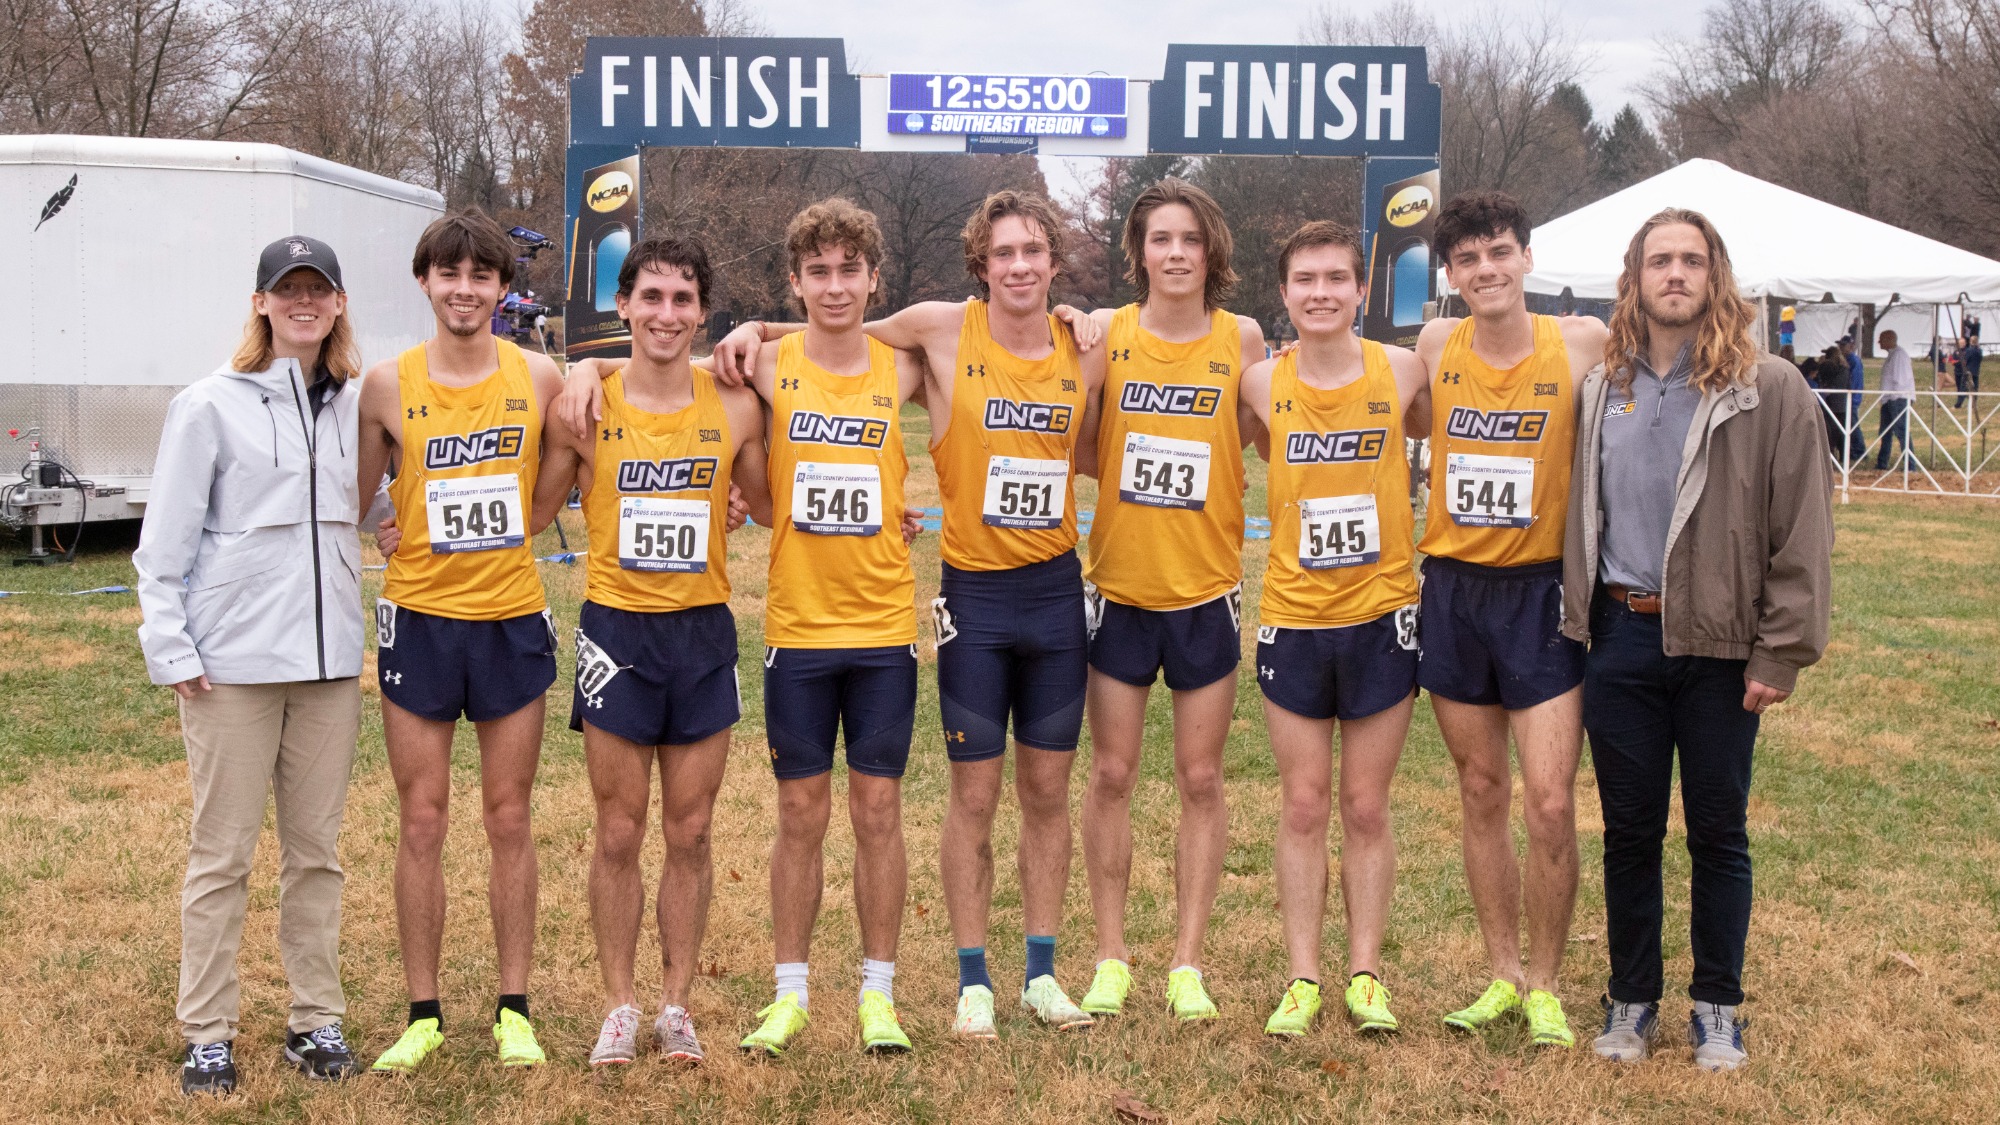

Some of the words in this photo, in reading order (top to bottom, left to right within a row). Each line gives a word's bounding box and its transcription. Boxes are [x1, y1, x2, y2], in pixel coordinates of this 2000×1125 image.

[601, 56, 829, 128] FINISH
[926, 75, 1091, 111] 12:55:00
[1184, 61, 1406, 140] FINISH
[931, 114, 1023, 133] SOUTHEAST
[1025, 117, 1085, 134] REGION
[979, 136, 1034, 144] CHAMPIONSHIPS
[590, 184, 630, 207] NCAA
[1389, 199, 1429, 221] NCAA
[1209, 361, 1231, 376] SOCON
[505, 398, 528, 412] SOCON
[872, 395, 893, 409] SOCON
[1120, 382, 1223, 417] UNCG
[1534, 383, 1558, 396] SOCON
[984, 398, 1073, 434] UNCG
[1368, 401, 1391, 415] SOCON
[1447, 408, 1550, 442] UNCG
[699, 429, 722, 443] SOCON
[789, 411, 889, 449] UNCG
[1286, 429, 1388, 463] UNCG
[425, 427, 525, 470] UNCG
[618, 458, 718, 492] UNCG
[1133, 458, 1195, 498] 543
[807, 488, 868, 523] 546
[1000, 481, 1052, 516] 551
[1134, 494, 1163, 504] SOUTHEAST
[1164, 498, 1187, 506] REGIONAL
[1457, 479, 1517, 515] 544
[443, 500, 508, 539] 549
[450, 541, 481, 550] SOUTHEAST
[481, 538, 506, 547] REGIONAL
[634, 523, 696, 559] 550
[1309, 519, 1366, 557] 545
[637, 561, 667, 569] SOUTHEAST
[1312, 558, 1339, 567] SOUTHEAST
[1340, 556, 1364, 564] REGIONAL
